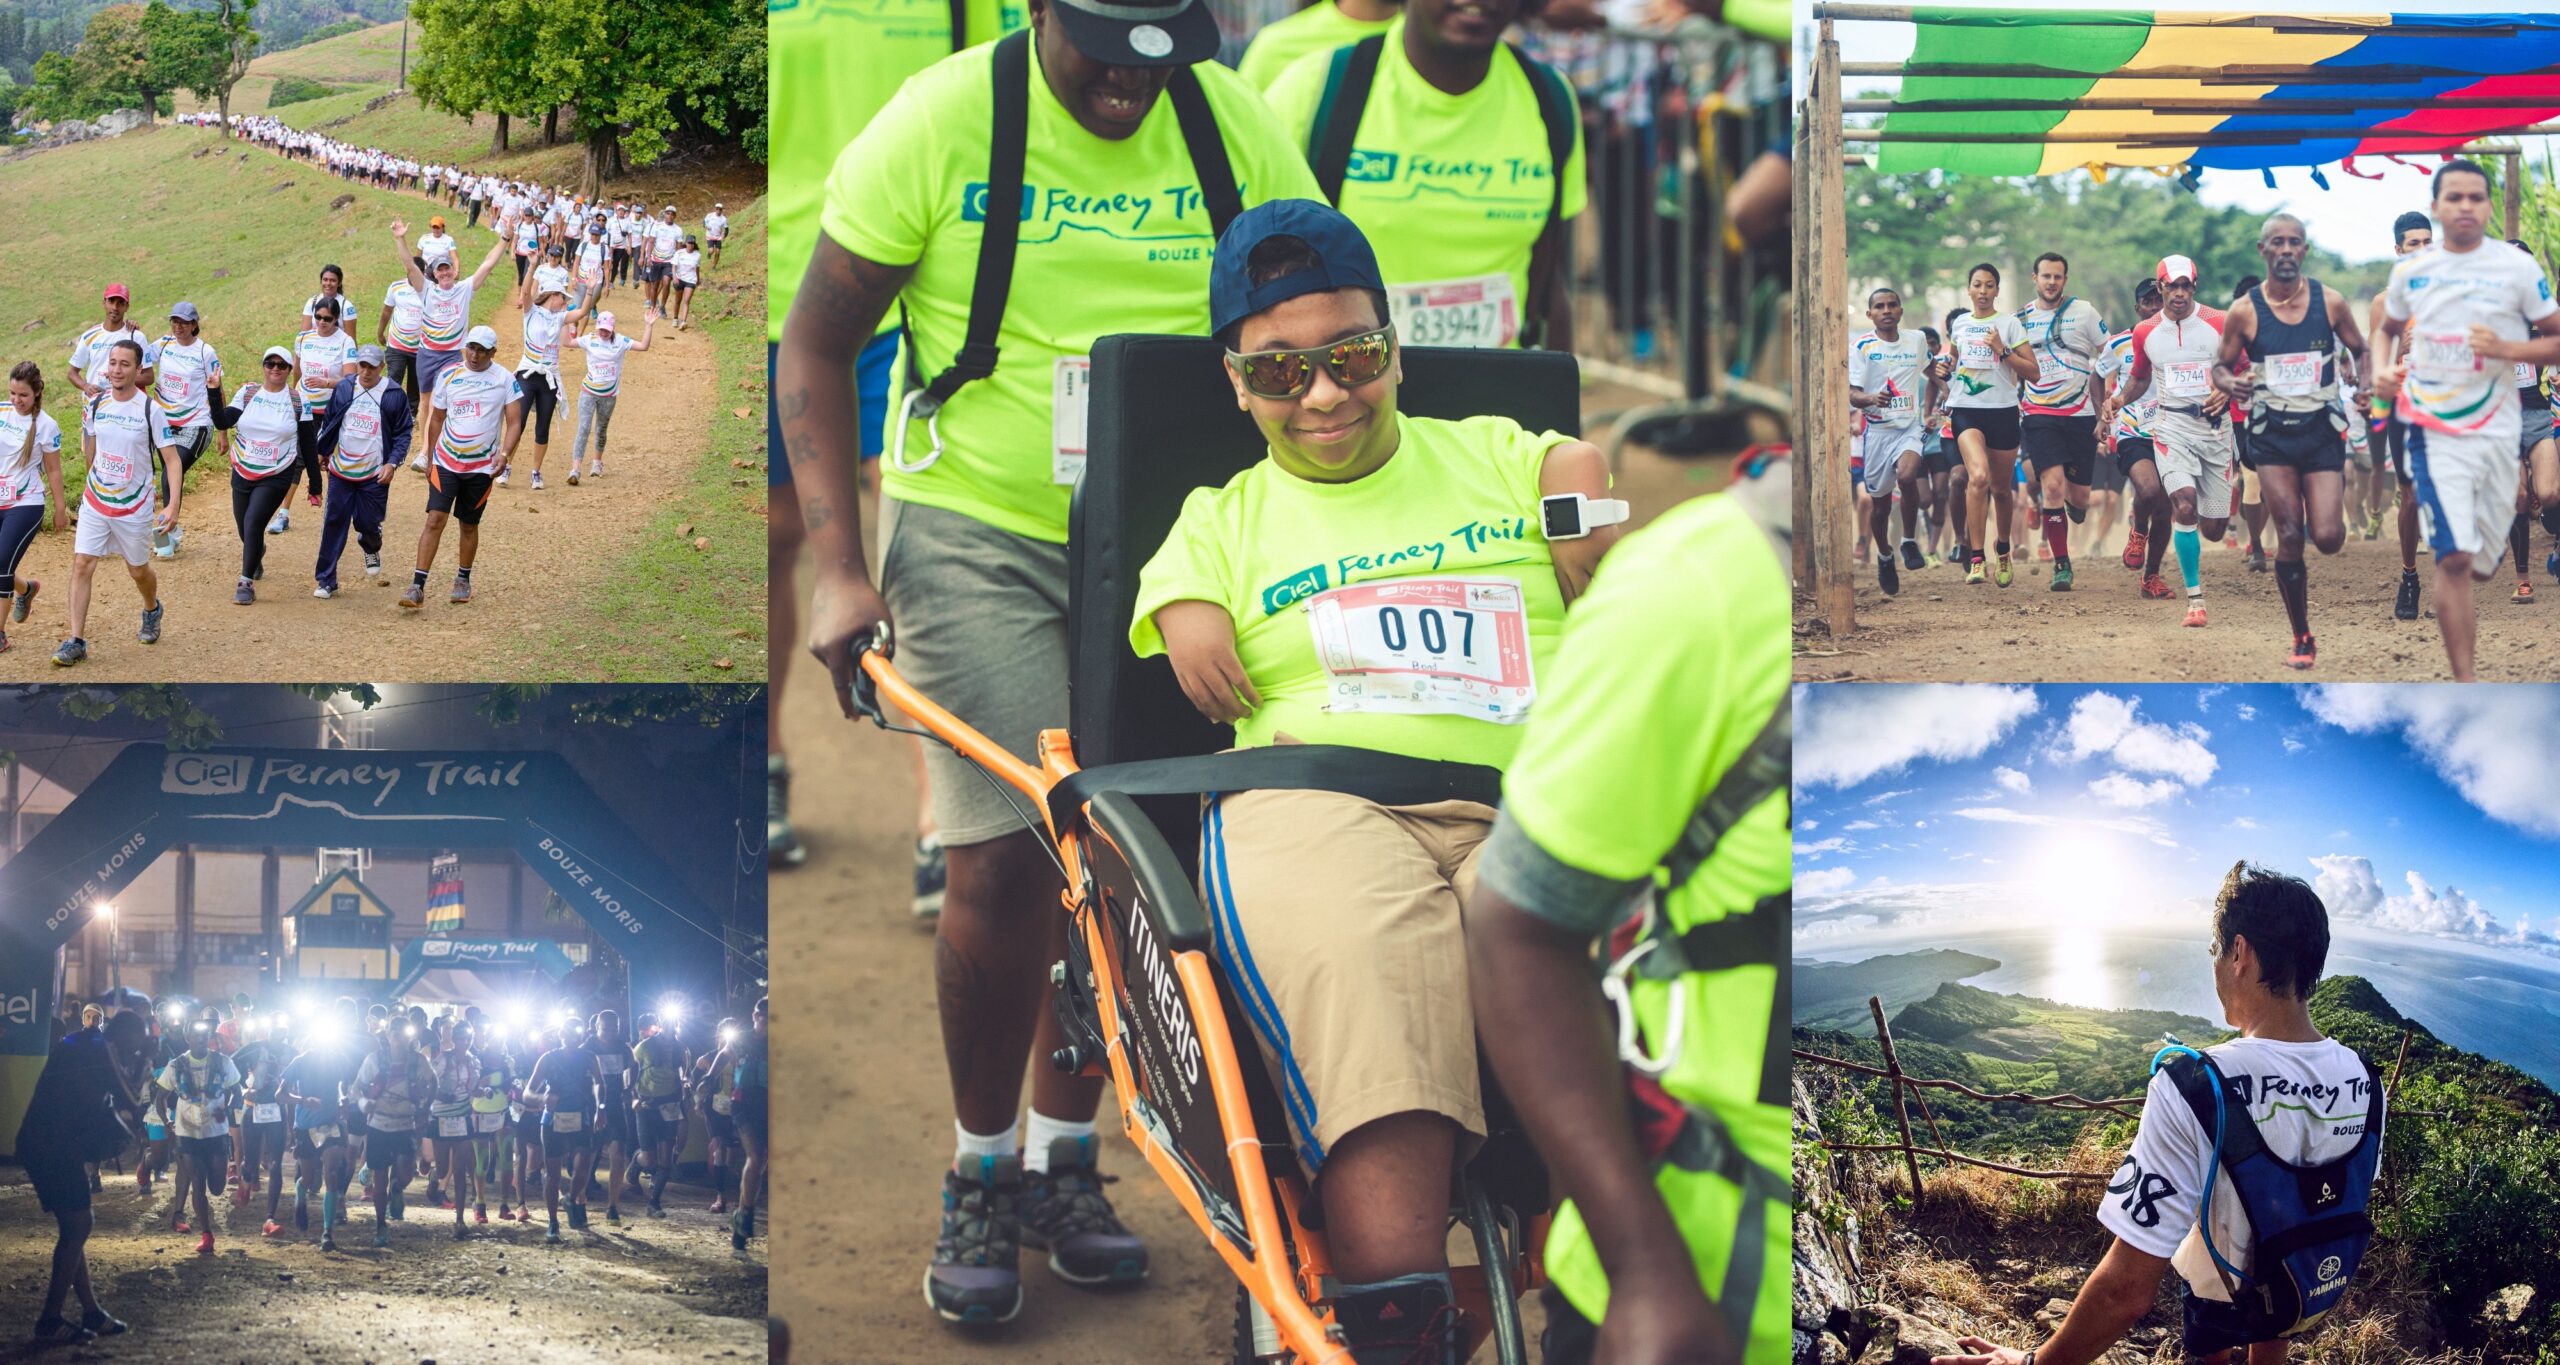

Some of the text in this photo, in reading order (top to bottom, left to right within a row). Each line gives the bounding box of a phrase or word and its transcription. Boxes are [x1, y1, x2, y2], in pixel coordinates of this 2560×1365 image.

[1404, 154, 1493, 191] Ferney
[1044, 188, 1151, 230] Ferney
[1148, 249, 1199, 261] BOUZE
[1410, 302, 1497, 343] 83947
[1967, 345, 1993, 357] 24339
[2174, 370, 2204, 383] 75744
[2276, 363, 2314, 378] 75908
[352, 418, 374, 430] 29205
[101, 457, 126, 474] 83956
[250, 445, 273, 457] 26959
[1271, 518, 1525, 606] Ciel Ferney Trail
[1378, 606, 1475, 658] 007
[1338, 682, 1362, 695] Ciel
[174, 757, 528, 807] Ciel Ferney Trail
[45, 832, 147, 931] BOUZE MORIS
[538, 837, 644, 934] BOUZE MORIS
[451, 942, 498, 959] Ferney
[502, 942, 539, 955] Trail
[1130, 897, 1201, 1084] ITINERIS
[0, 988, 37, 1024] iel
[2260, 1075, 2340, 1114] Ferney
[2345, 1077, 2371, 1103] Tra
[2333, 1123, 2365, 1136] BOUZE
[2308, 1275, 2348, 1298] YAMAHA
